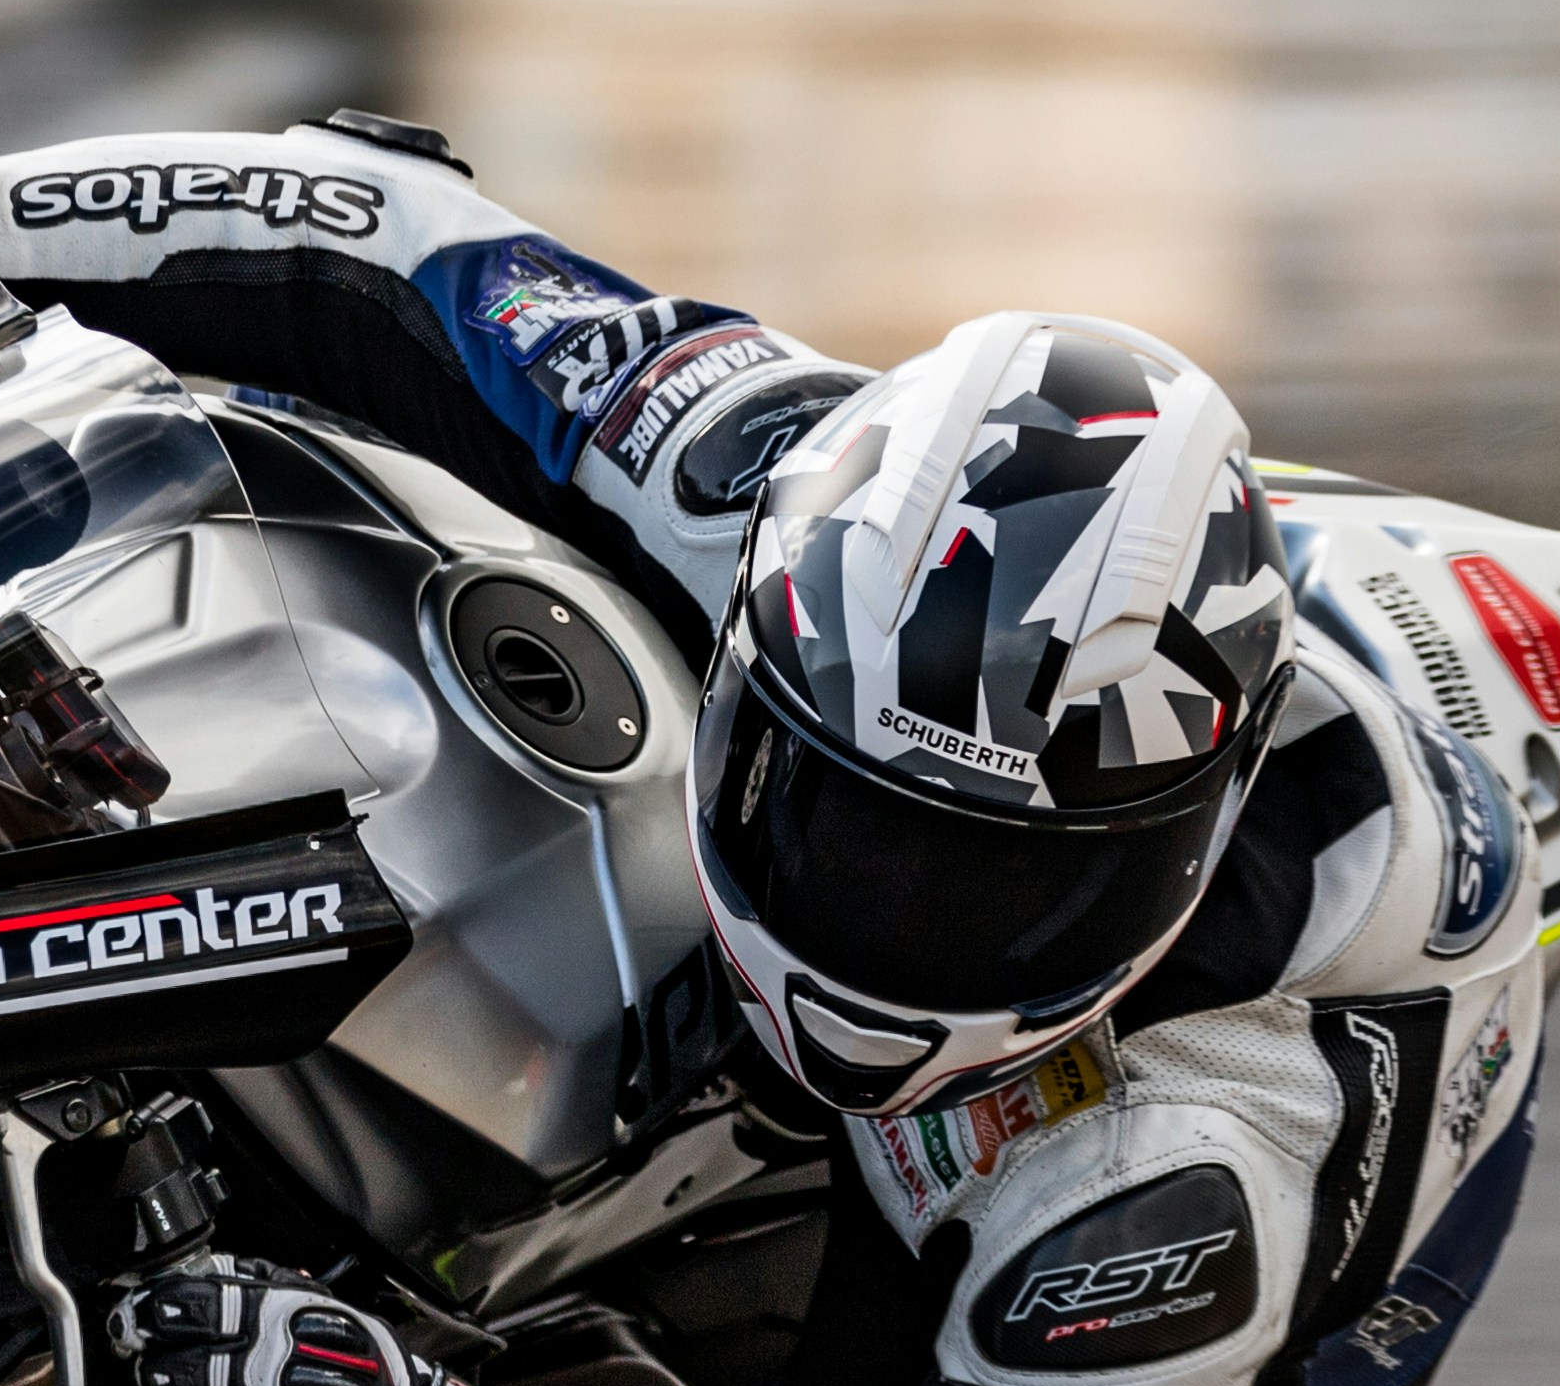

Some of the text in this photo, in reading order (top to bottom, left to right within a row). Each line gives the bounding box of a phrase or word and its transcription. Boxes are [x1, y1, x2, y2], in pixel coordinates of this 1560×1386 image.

[14, 165, 383, 236] Stratos
[618, 339, 774, 470] YAMALUBE
[876, 706, 1029, 777] SCHUBERTH
[1006, 1230, 1236, 1322] RST
